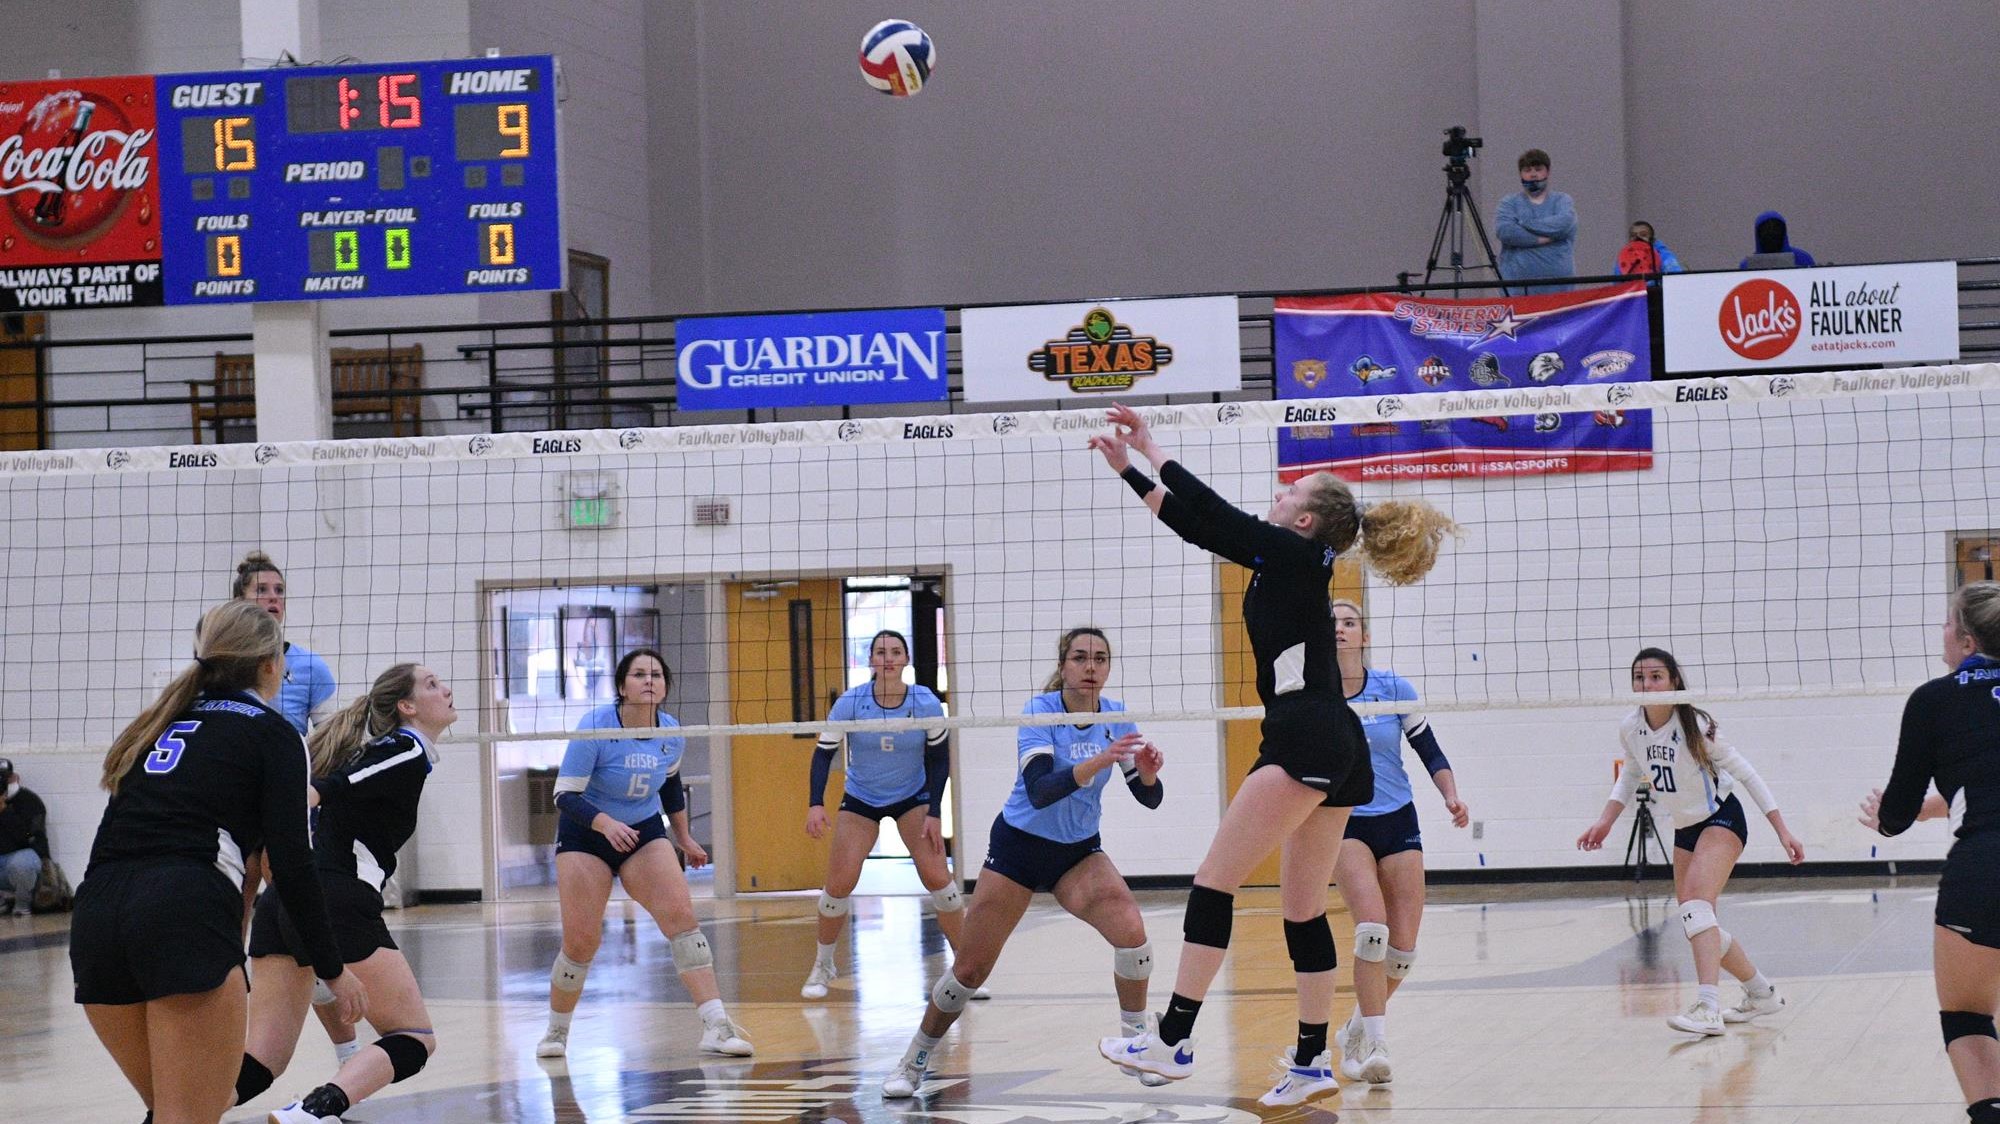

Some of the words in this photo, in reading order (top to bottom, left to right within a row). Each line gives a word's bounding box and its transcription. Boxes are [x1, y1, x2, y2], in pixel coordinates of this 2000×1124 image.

[449, 69, 531, 94] HOME
[172, 82, 261, 108] GUEST
[338, 74, 421, 130] 1:15
[497, 104, 529, 158] 9
[213, 117, 256, 171] 15
[0, 128, 154, 195] Coca-Cola
[285, 160, 364, 182] PERIOD
[300, 208, 416, 226] PLAYER-FOUL
[468, 202, 522, 219] FOULS
[196, 214, 249, 231] FOULS
[335, 231, 358, 271] 0
[386, 228, 410, 269] 0
[488, 223, 514, 265] 0
[216, 235, 241, 276] 0
[0, 267, 73, 288] ALWAYS
[78, 266, 129, 284] PART
[134, 264, 160, 282] OF
[304, 275, 365, 292] MATCH
[467, 268, 528, 285] POINTS
[15, 287, 67, 306] YOUR
[71, 284, 133, 303] TEAM!
[195, 279, 255, 296] POINTS
[1810, 280, 1841, 307] ALL
[1845, 281, 1900, 305] about
[1394, 301, 1503, 320] SOUTHERN
[1726, 290, 1796, 344] Jack's
[1411, 317, 1488, 335] STATES
[1811, 308, 1902, 336] FAULKNER
[1811, 338, 1896, 353] eatatjacks.com
[678, 330, 943, 389] GUARDIAN
[1050, 341, 1153, 374] TEXAS
[727, 372, 808, 387] CREDIT
[814, 369, 885, 384] UNION
[1072, 374, 1132, 387] ROADHOUSE
[1832, 374, 1896, 392] Faulkner
[1900, 371, 1970, 390] Volleyball
[1438, 396, 1500, 413] Faulkner
[1503, 391, 1571, 410] Volleyball
[1675, 385, 1729, 403] EAGLES
[1284, 405, 1336, 423] EAGLES
[678, 431, 736, 446] Faulkner
[740, 428, 804, 445] Volleyball
[903, 423, 954, 440] EAGLES
[312, 446, 369, 461] Faulkner
[373, 443, 436, 458] Volleyball
[532, 437, 582, 454] EAGLES
[12, 456, 73, 472] Volleyball
[169, 452, 218, 469] EAGLES
[1362, 463, 1469, 476] SSACSPORTS.COM
[144, 720, 202, 773] 5
[880, 736, 894, 752] 6
[623, 753, 658, 770] KEISER
[627, 772, 650, 798] 15
[1651, 764, 1677, 793] 20
